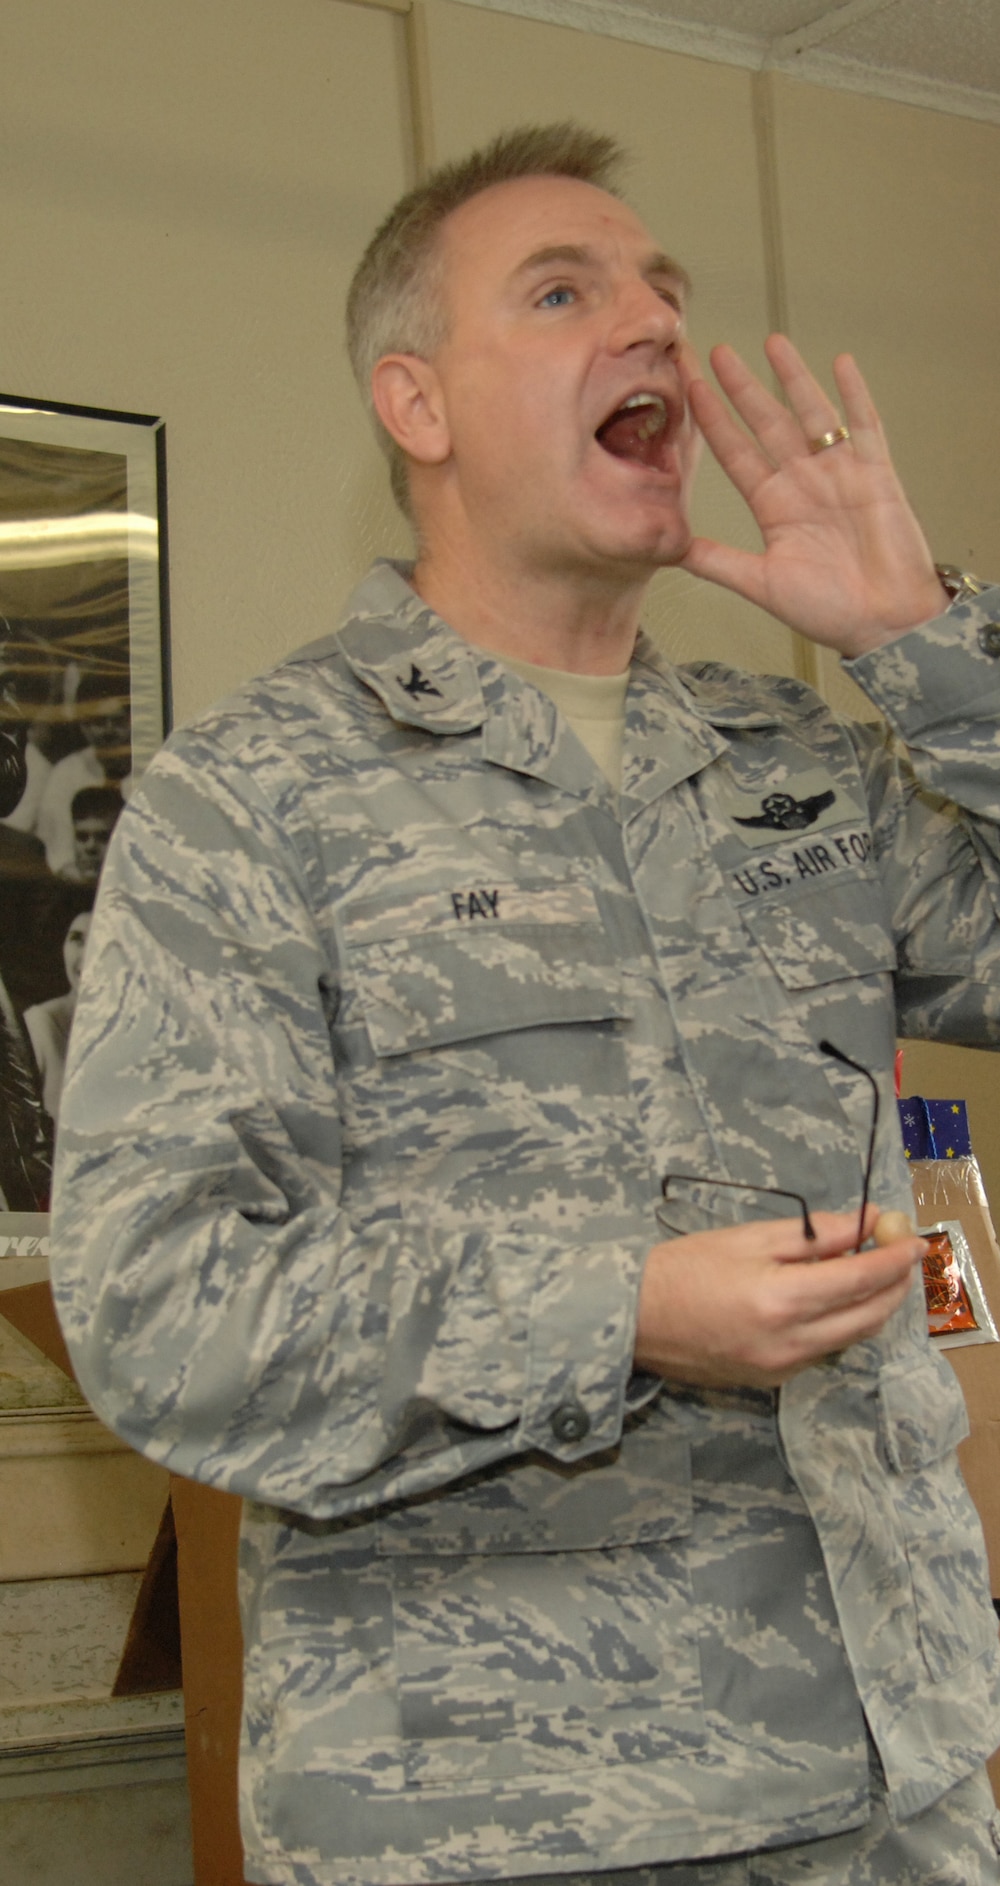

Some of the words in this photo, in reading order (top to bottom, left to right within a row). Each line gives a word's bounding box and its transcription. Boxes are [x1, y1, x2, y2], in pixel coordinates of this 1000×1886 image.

[733, 861, 791, 896] U.S.
[792, 844, 837, 880] AIR
[451, 889, 499, 920] FAY
